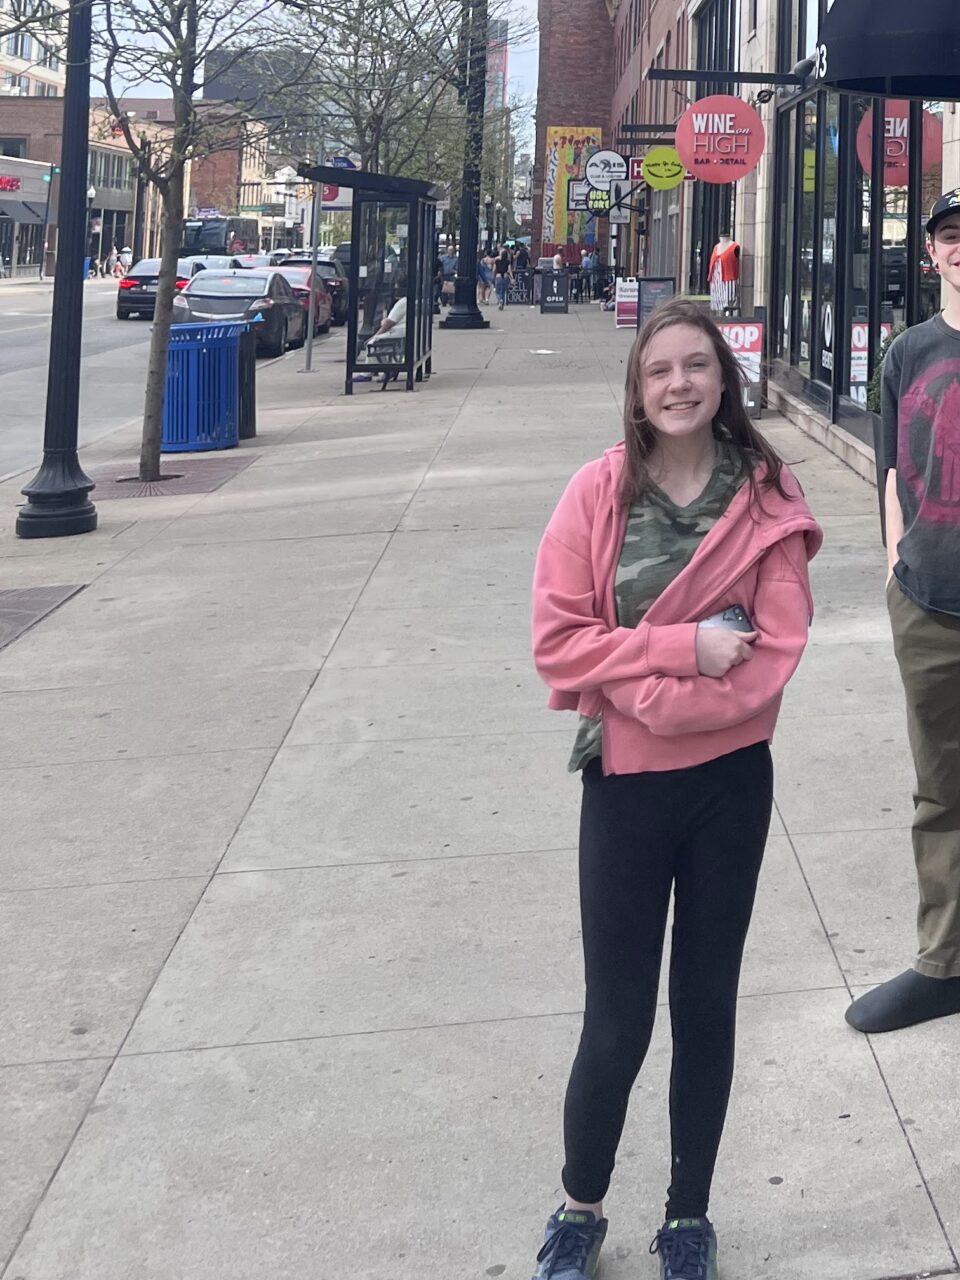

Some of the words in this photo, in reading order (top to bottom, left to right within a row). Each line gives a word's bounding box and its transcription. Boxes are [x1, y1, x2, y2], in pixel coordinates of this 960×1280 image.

[692, 113, 736, 134] WINE
[735, 127, 751, 135] on
[693, 135, 749, 154] HIGH
[508, 281, 528, 292] SELL
[507, 292, 529, 303] CRACK
[719, 325, 760, 349] HOP
